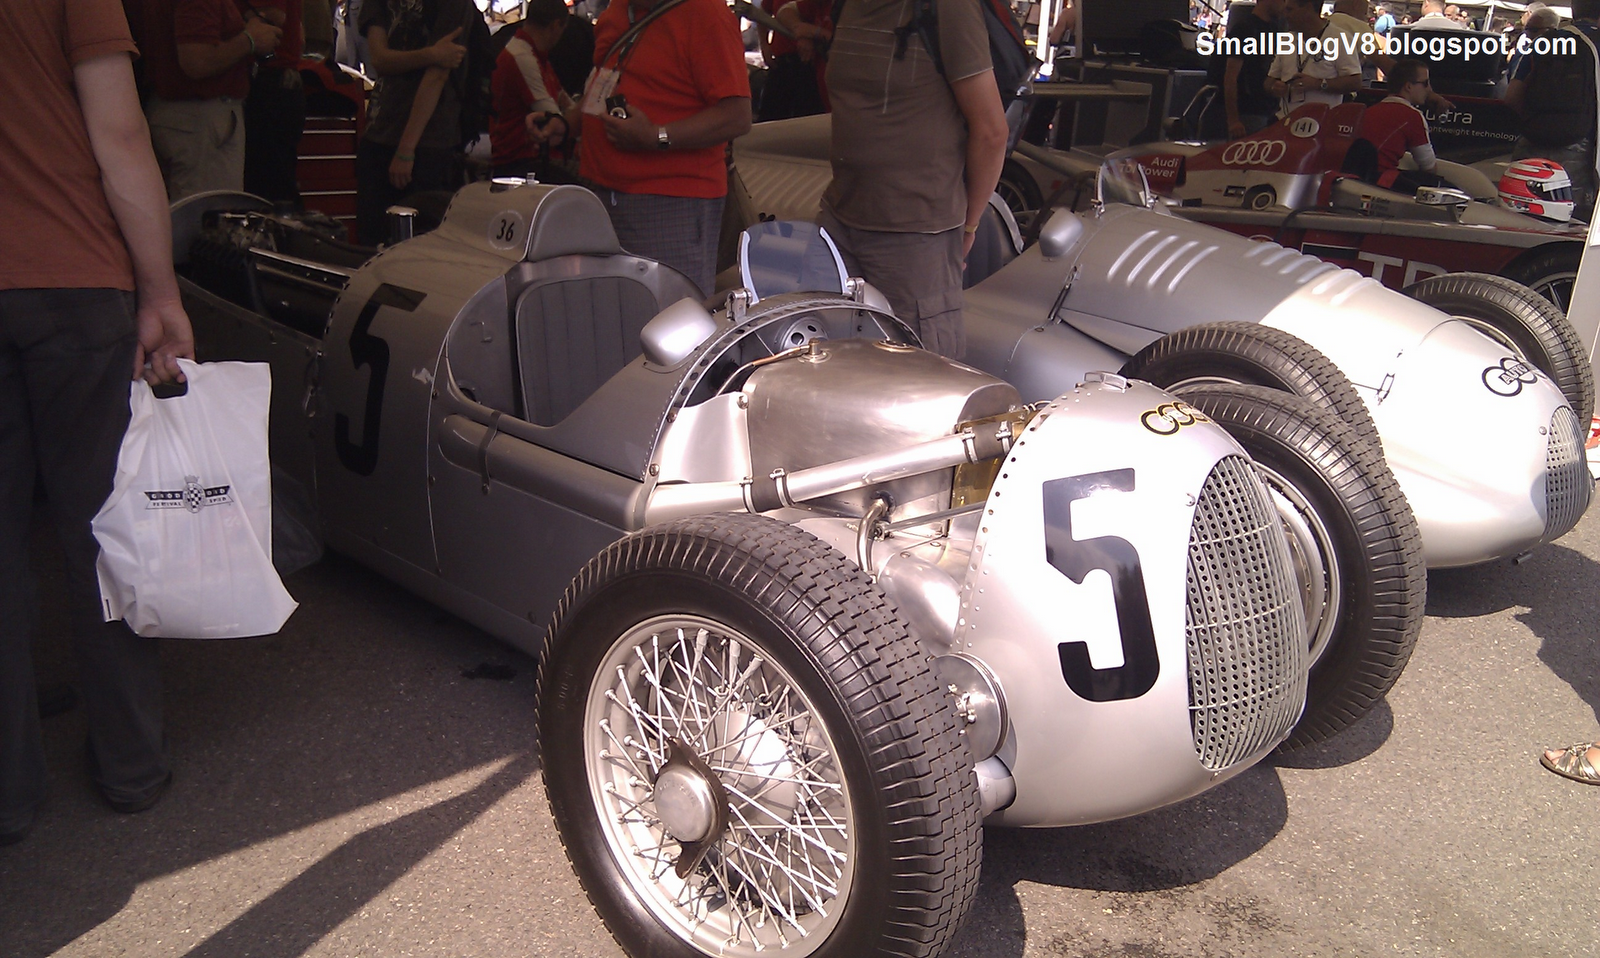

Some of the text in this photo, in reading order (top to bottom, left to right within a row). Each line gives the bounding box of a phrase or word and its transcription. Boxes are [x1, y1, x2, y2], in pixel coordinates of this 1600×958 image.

[1426, 109, 1473, 124] utra
[1295, 122, 1312, 133] 141
[1338, 125, 1353, 133] TDI
[1472, 130, 1520, 142] technology
[1151, 157, 1179, 168] Audi
[496, 219, 515, 242] 36
[335, 282, 427, 477] 5
[1500, 364, 1529, 385] AUTO
[1042, 467, 1160, 703] 5
